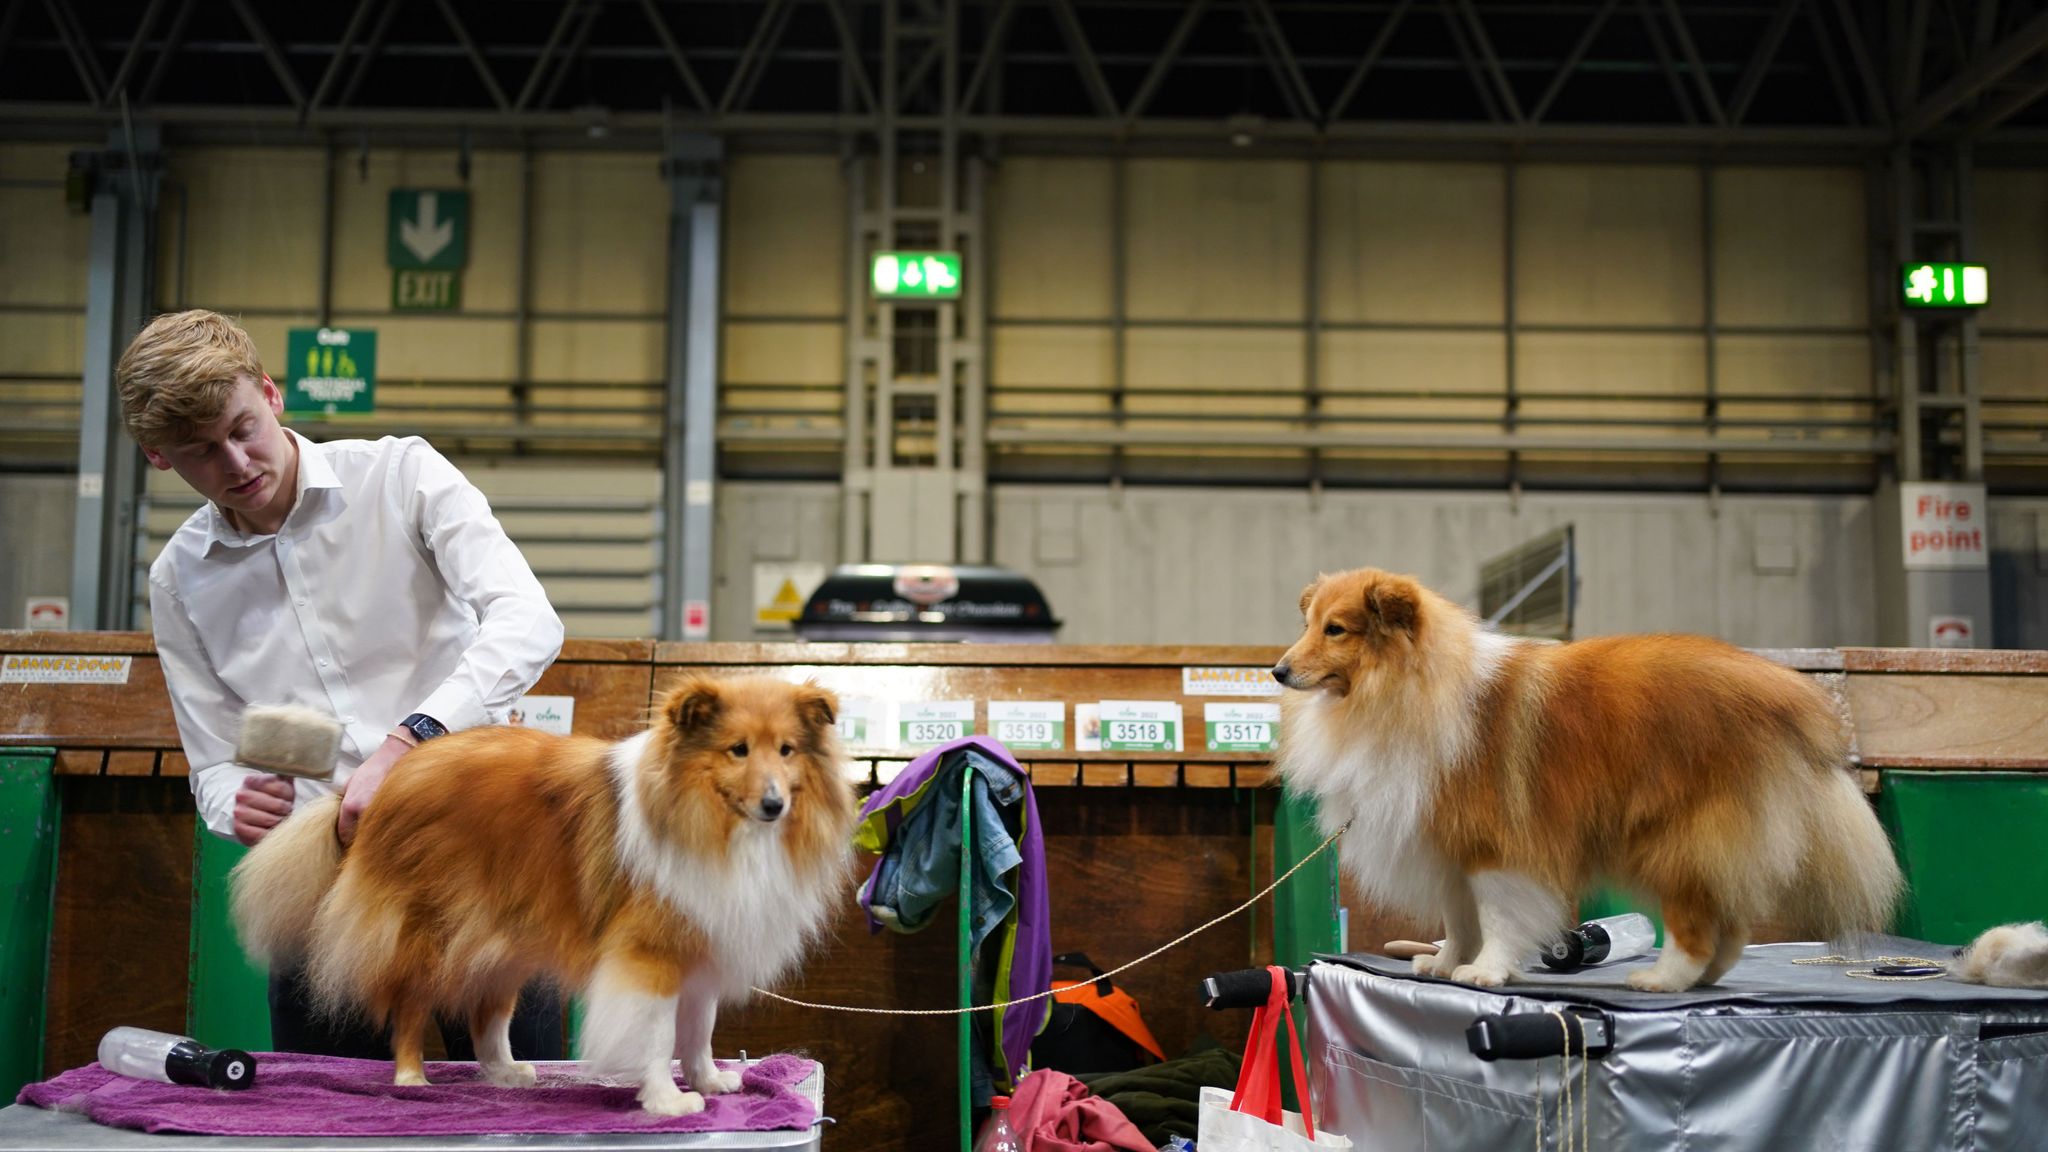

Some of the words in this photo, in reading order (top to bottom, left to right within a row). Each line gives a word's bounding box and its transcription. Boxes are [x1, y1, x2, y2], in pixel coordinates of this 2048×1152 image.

[399, 271, 454, 305] EXIT
[1918, 496, 1971, 521] Fire
[1911, 526, 1981, 555] point
[7, 658, 125, 671] BANNERDOWN
[915, 723, 956, 740] 3520
[1005, 721, 1046, 740] 3519
[1117, 723, 1158, 740] 3518
[1223, 724, 1263, 740] 3517
